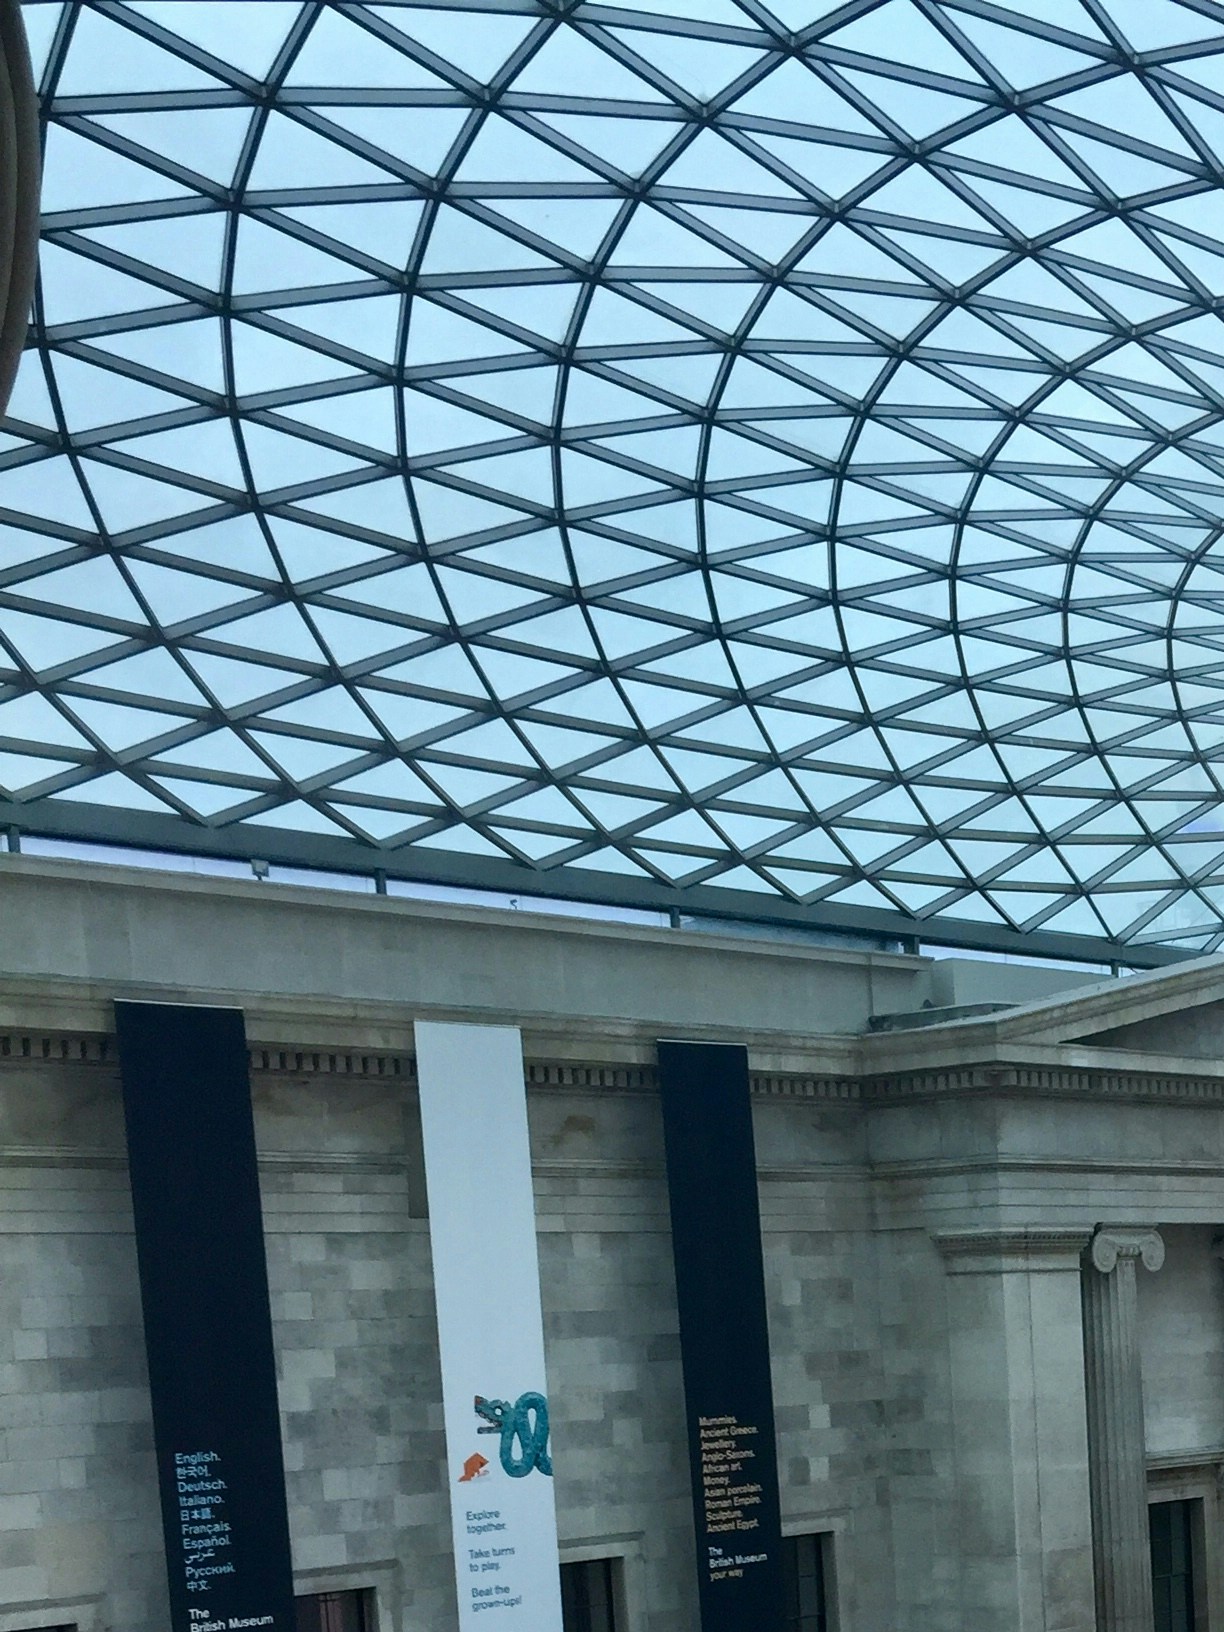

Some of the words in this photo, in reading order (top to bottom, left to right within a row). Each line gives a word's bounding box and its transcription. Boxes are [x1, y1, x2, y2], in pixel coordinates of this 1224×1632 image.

[701, 1427, 729, 1438] Ancient
[730, 1426, 758, 1436] Greece.
[175, 1452, 221, 1465] English.
[703, 1464, 729, 1474] African
[178, 1480, 227, 1492] Deutsch.
[705, 1487, 725, 1497] Asian
[179, 1495, 225, 1507] Italiano.
[705, 1499, 732, 1509] Roman
[734, 1495, 762, 1507] Empire.
[466, 1510, 500, 1521] Explore
[182, 1521, 231, 1535] Français.
[707, 1522, 735, 1533] Ancient
[183, 1535, 231, 1550] Español.
[468, 1549, 490, 1559] Take
[492, 1547, 515, 1556] turns
[709, 1547, 723, 1556] The
[709, 1557, 733, 1568] British
[736, 1553, 767, 1564] Museum
[470, 1563, 479, 1572] to
[710, 1570, 726, 1582] your
[729, 1568, 743, 1578] way
[471, 1587, 493, 1598] Beat
[495, 1585, 510, 1594] the
[188, 1608, 210, 1619] The
[229, 1615, 274, 1629] Museum
